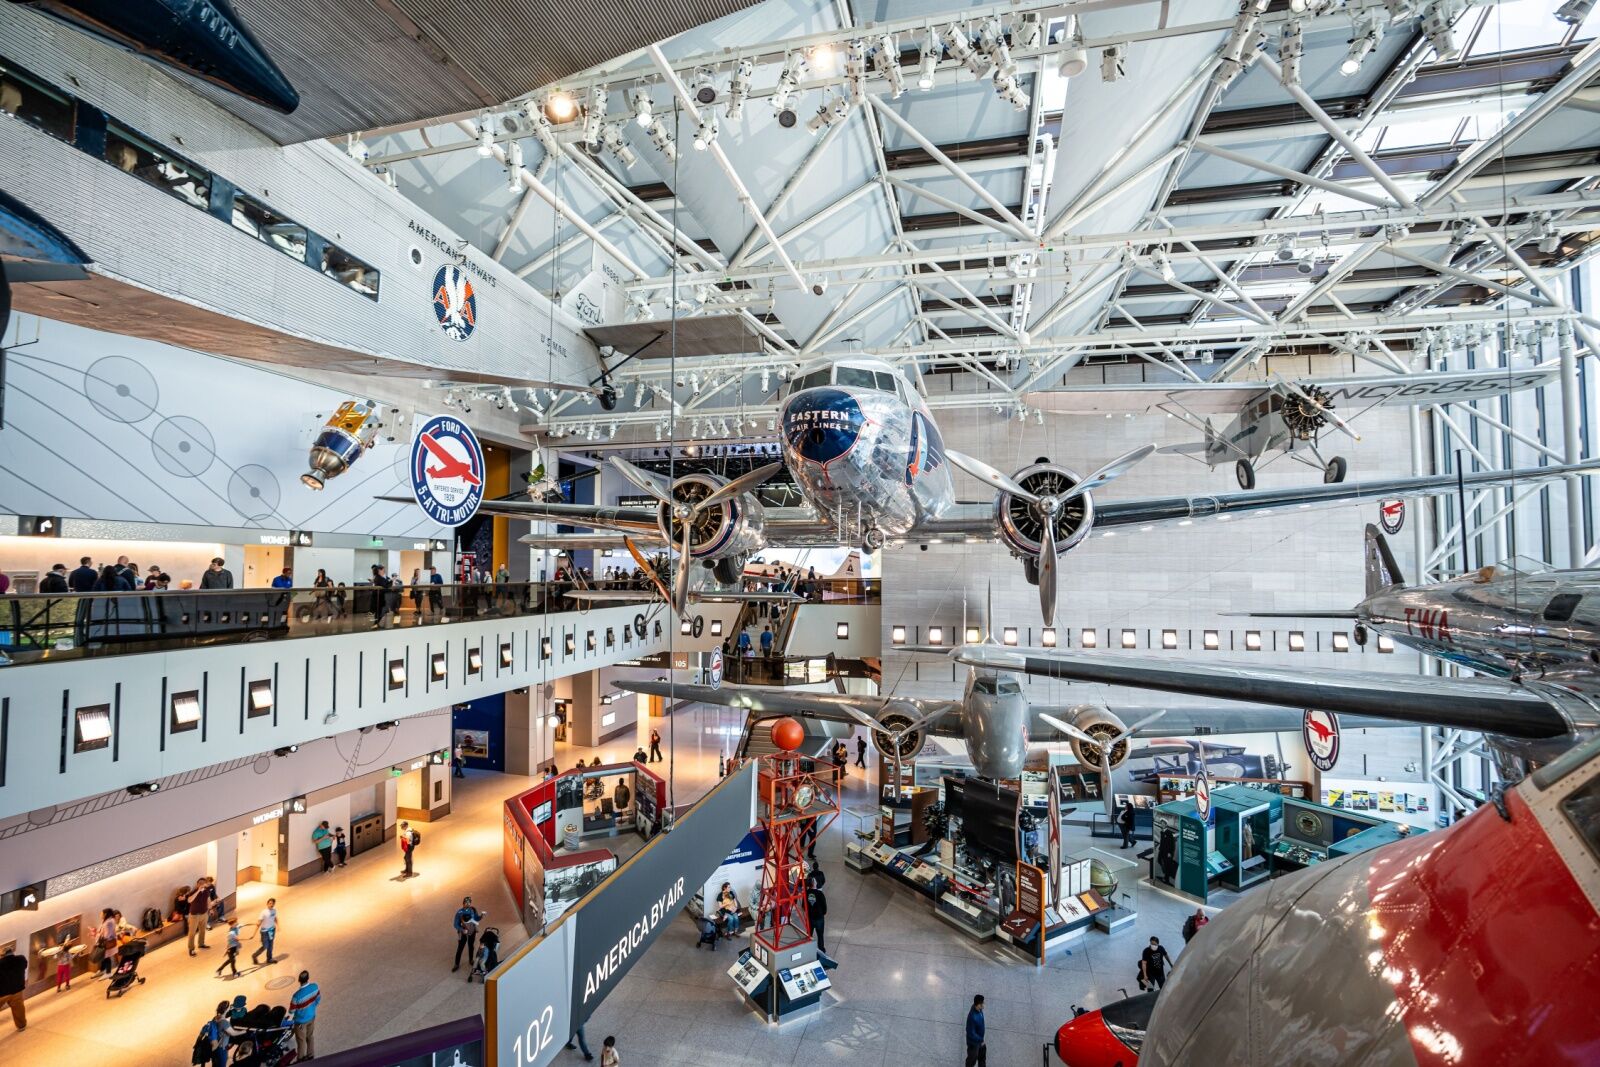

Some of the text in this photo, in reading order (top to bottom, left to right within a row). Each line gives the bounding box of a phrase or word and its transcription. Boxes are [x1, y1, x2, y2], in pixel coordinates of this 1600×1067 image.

[408, 219, 497, 288] AMERICAN AIRWAYS
[575, 292, 602, 325] Ford
[1331, 374, 1547, 400] NC6853
[441, 420, 461, 435] FORD
[790, 410, 849, 423] EASTERN
[796, 422, 842, 432] AIR LINES
[417, 485, 479, 523] 5-AT TRI-MOTOR
[260, 535, 291, 545] WOMEN
[1403, 607, 1454, 644] TWA
[675, 660, 687, 668] 105
[252, 807, 284, 825] WOMEN
[583, 876, 685, 1004] AMERICA BY AIR
[513, 1004, 554, 1067] 102
